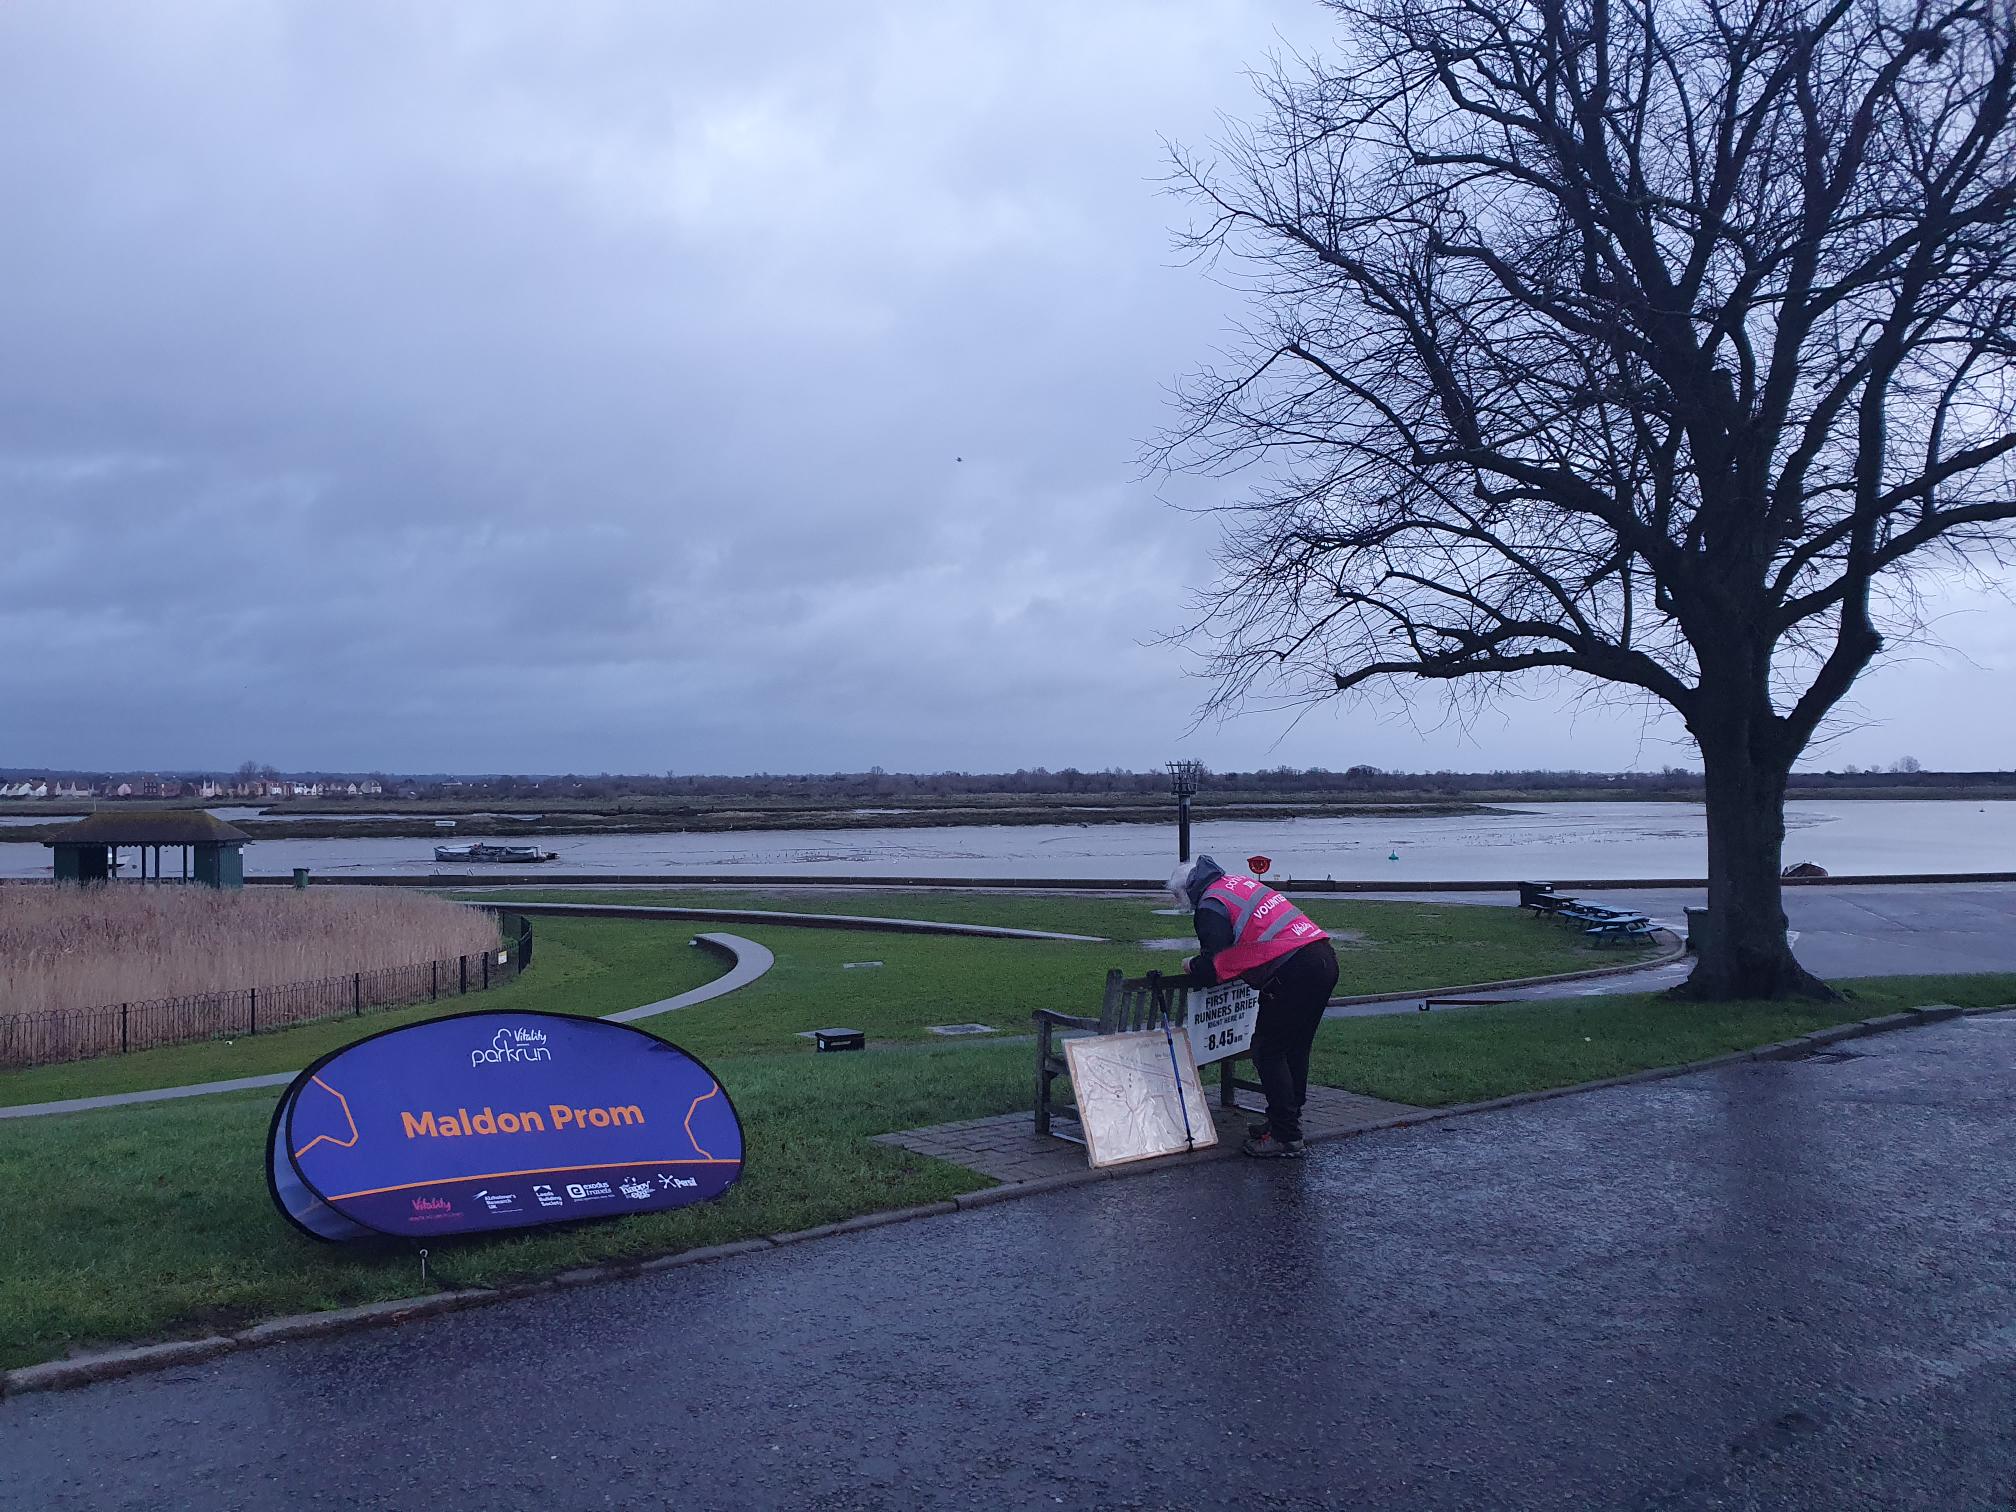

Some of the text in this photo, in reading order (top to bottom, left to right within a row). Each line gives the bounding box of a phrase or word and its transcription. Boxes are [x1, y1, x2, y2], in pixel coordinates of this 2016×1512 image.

[1205, 985, 1251, 1010] FIRST TIME
[1194, 1004, 1232, 1025] RUNNERS
[1207, 1019, 1222, 1029] RIGHT
[514, 1027, 547, 1045] Vitality
[471, 1038, 551, 1068] parkrun
[400, 1104, 645, 1139] Maldon Prom
[583, 1181, 610, 1190] exodus
[673, 1177, 698, 1189] Persil
[410, 1196, 452, 1213] Vitality
